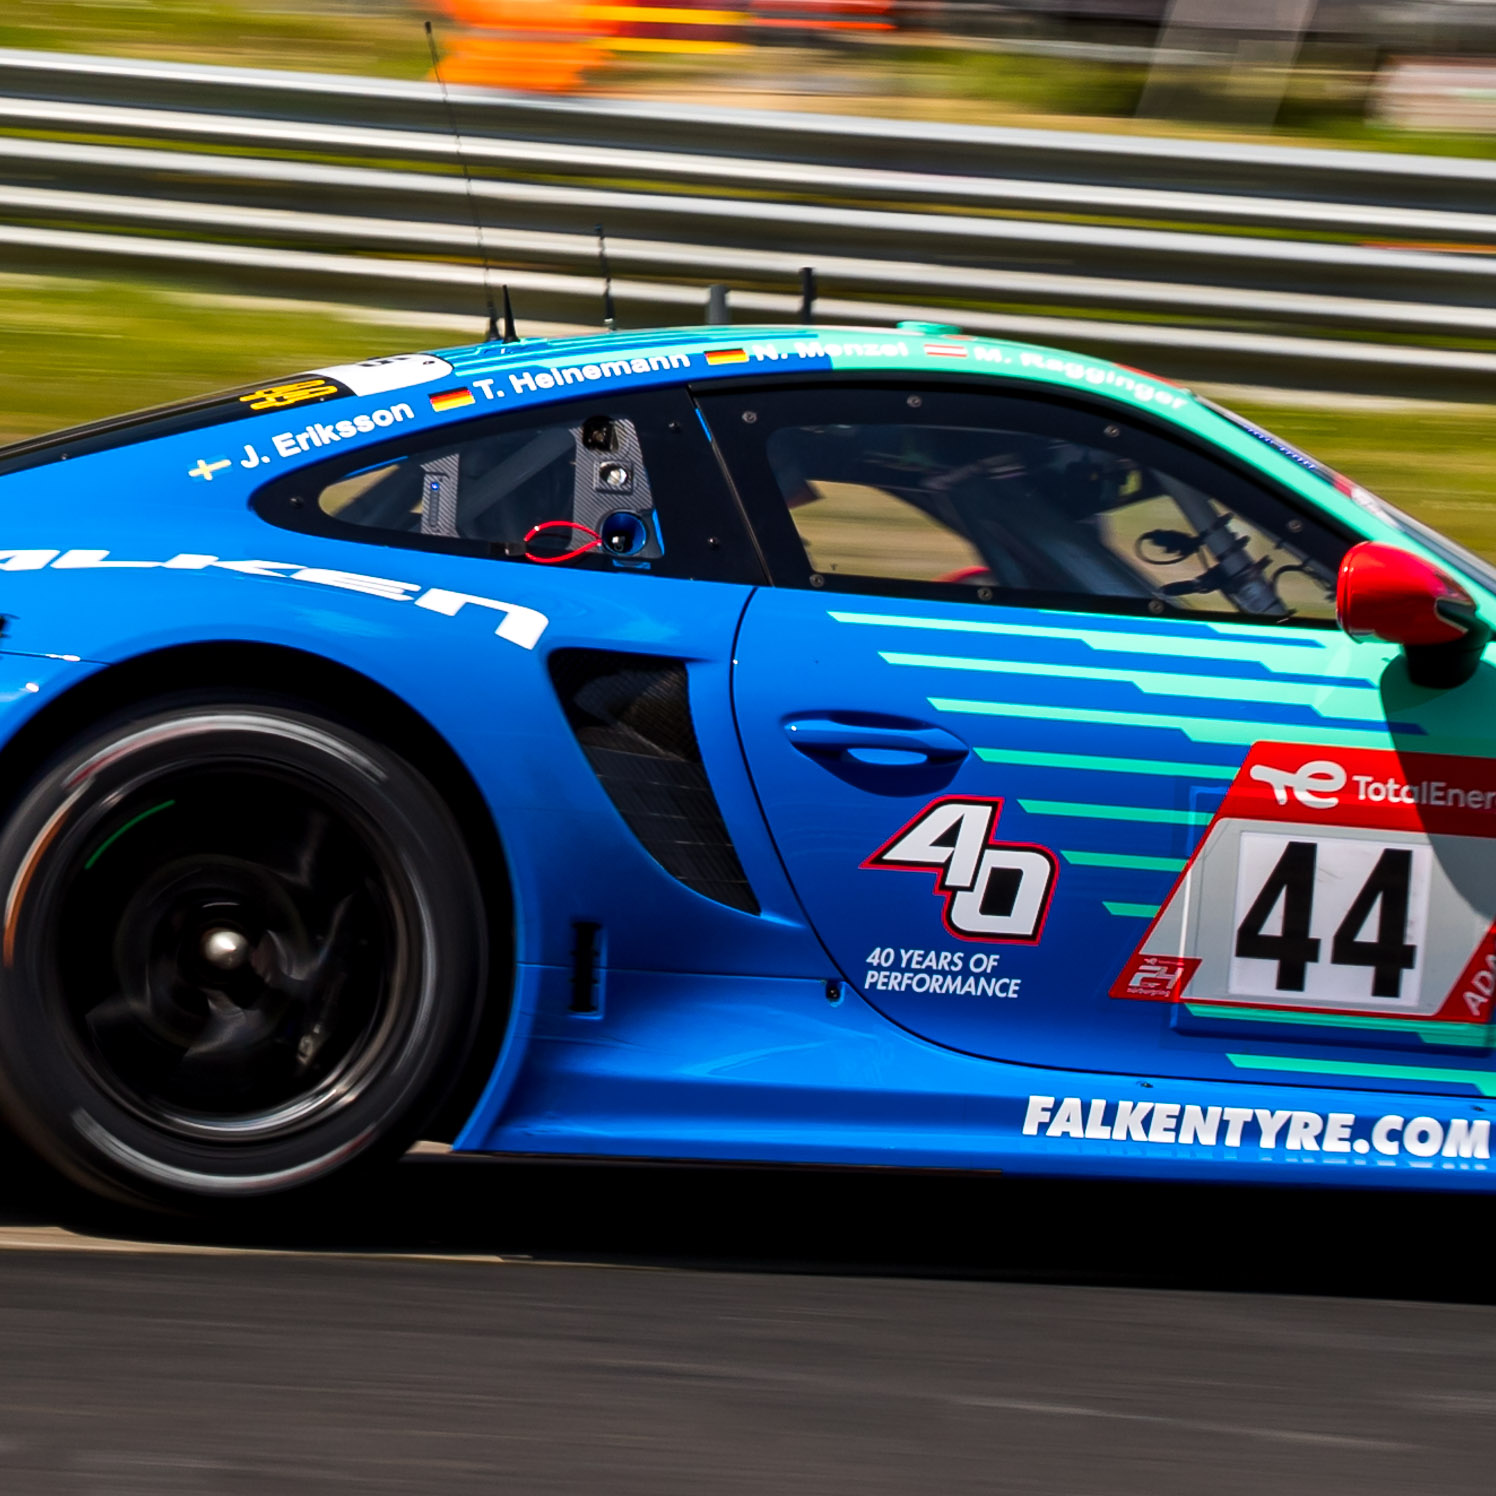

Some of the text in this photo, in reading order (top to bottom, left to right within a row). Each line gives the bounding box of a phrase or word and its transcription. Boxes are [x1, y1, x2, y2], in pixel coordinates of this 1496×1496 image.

[473, 352, 692, 401] T. Heinemann
[754, 343, 788, 362] N.
[972, 345, 1013, 365] M.
[240, 402, 415, 469] J. Eriksson
[859, 794, 1060, 946] 40
[1235, 840, 1418, 999] 44
[866, 947, 1000, 973] 40 YEARS OF
[864, 971, 1021, 999] PERFORMANCE
[1021, 1095, 1491, 1160] FALKENTYRE.COM
